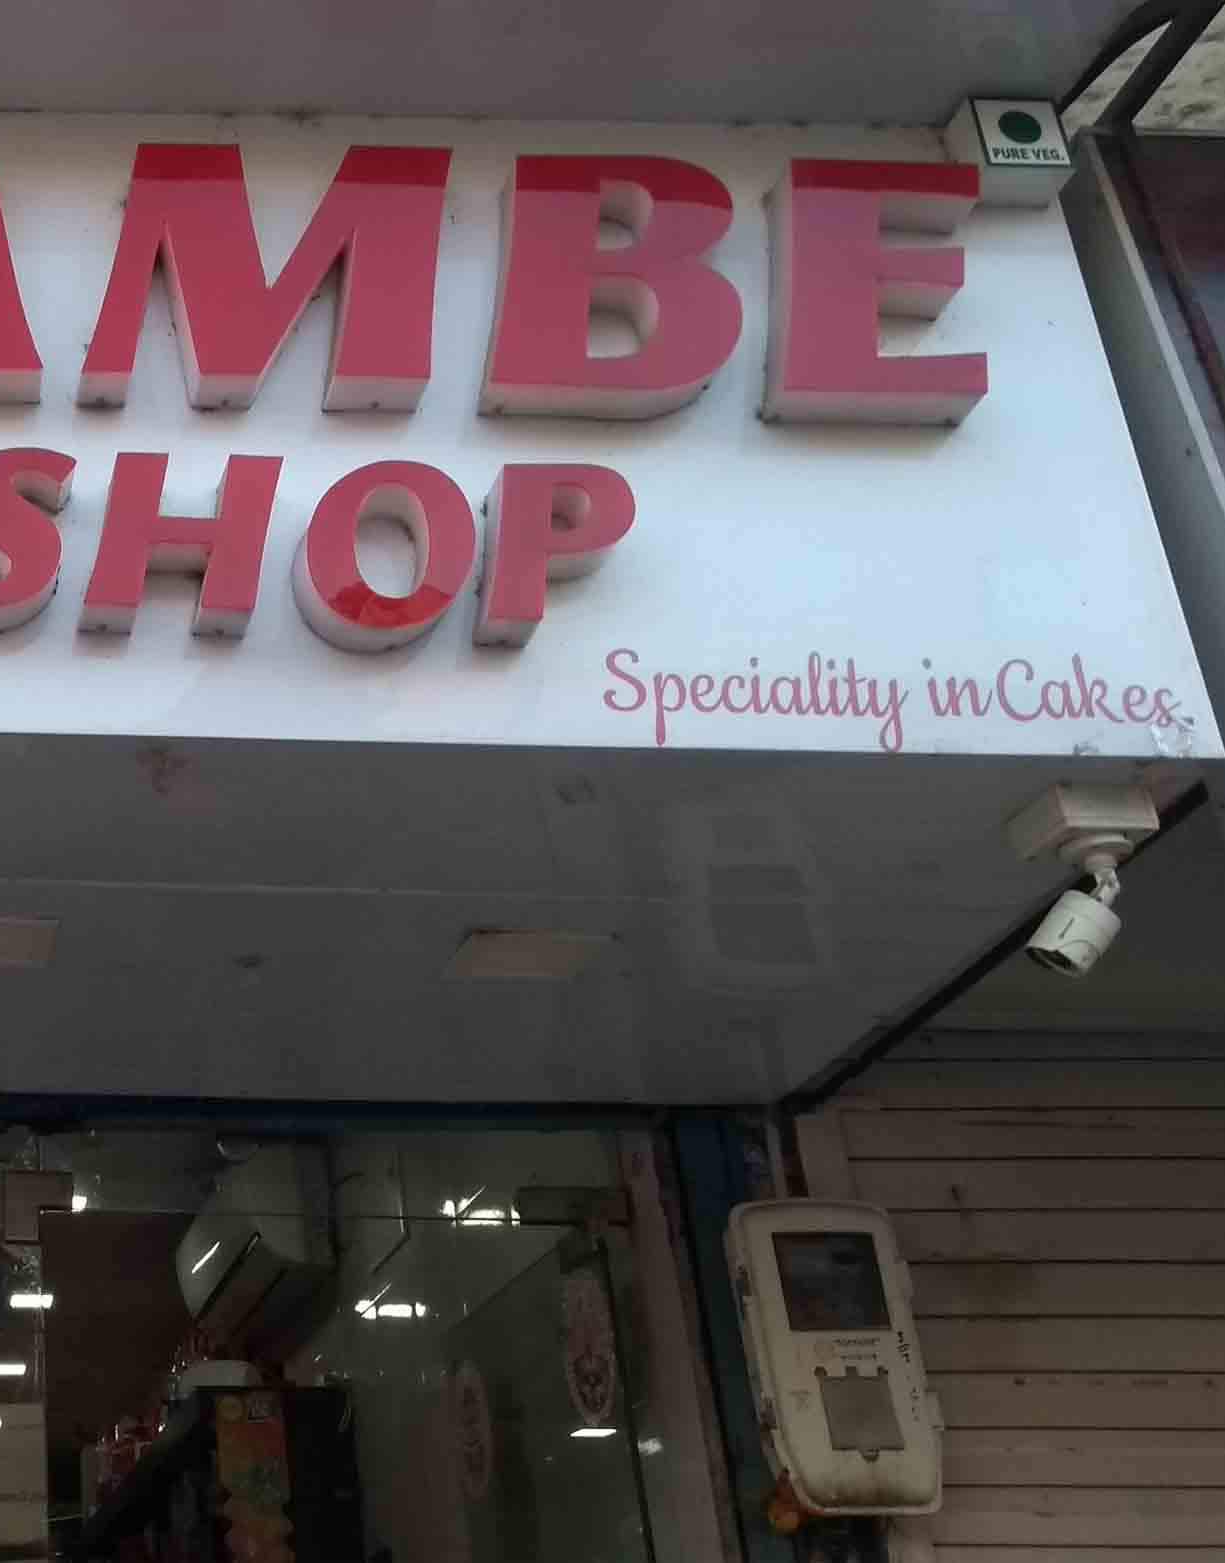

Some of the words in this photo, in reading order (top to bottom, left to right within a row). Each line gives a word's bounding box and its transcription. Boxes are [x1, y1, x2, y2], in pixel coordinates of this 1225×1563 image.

[991, 146, 1029, 160] PURE
[603, 648, 909, 753] Speciality
[922, 657, 993, 718] in
